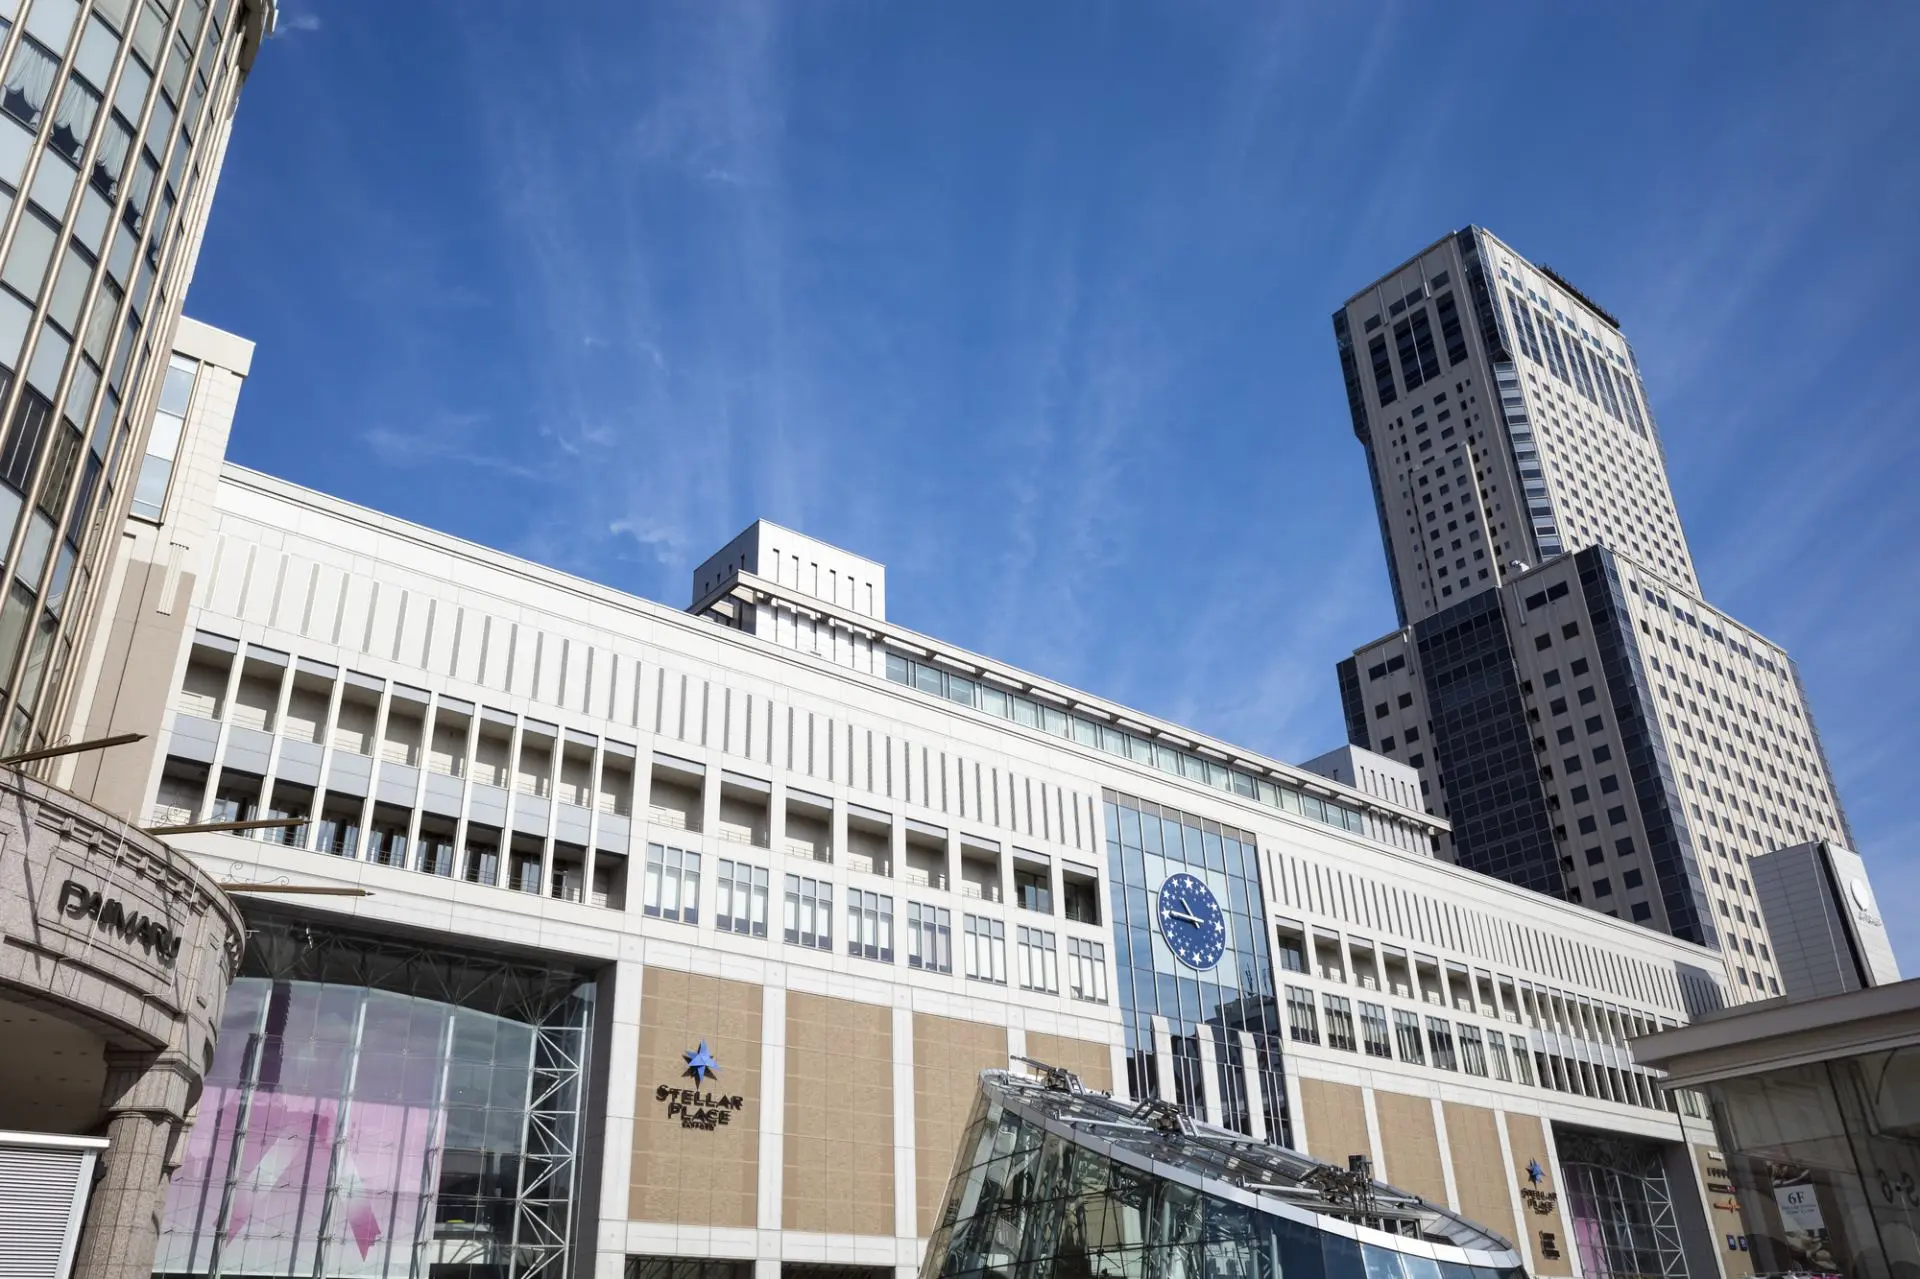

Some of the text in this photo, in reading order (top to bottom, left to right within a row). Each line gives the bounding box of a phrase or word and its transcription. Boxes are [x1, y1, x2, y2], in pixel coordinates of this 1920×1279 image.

[58, 880, 182, 960] DAIMARU
[656, 1085, 743, 1110] STELLAR
[668, 1102, 731, 1125] PLACE
[1787, 1191, 1804, 1204] 6F
